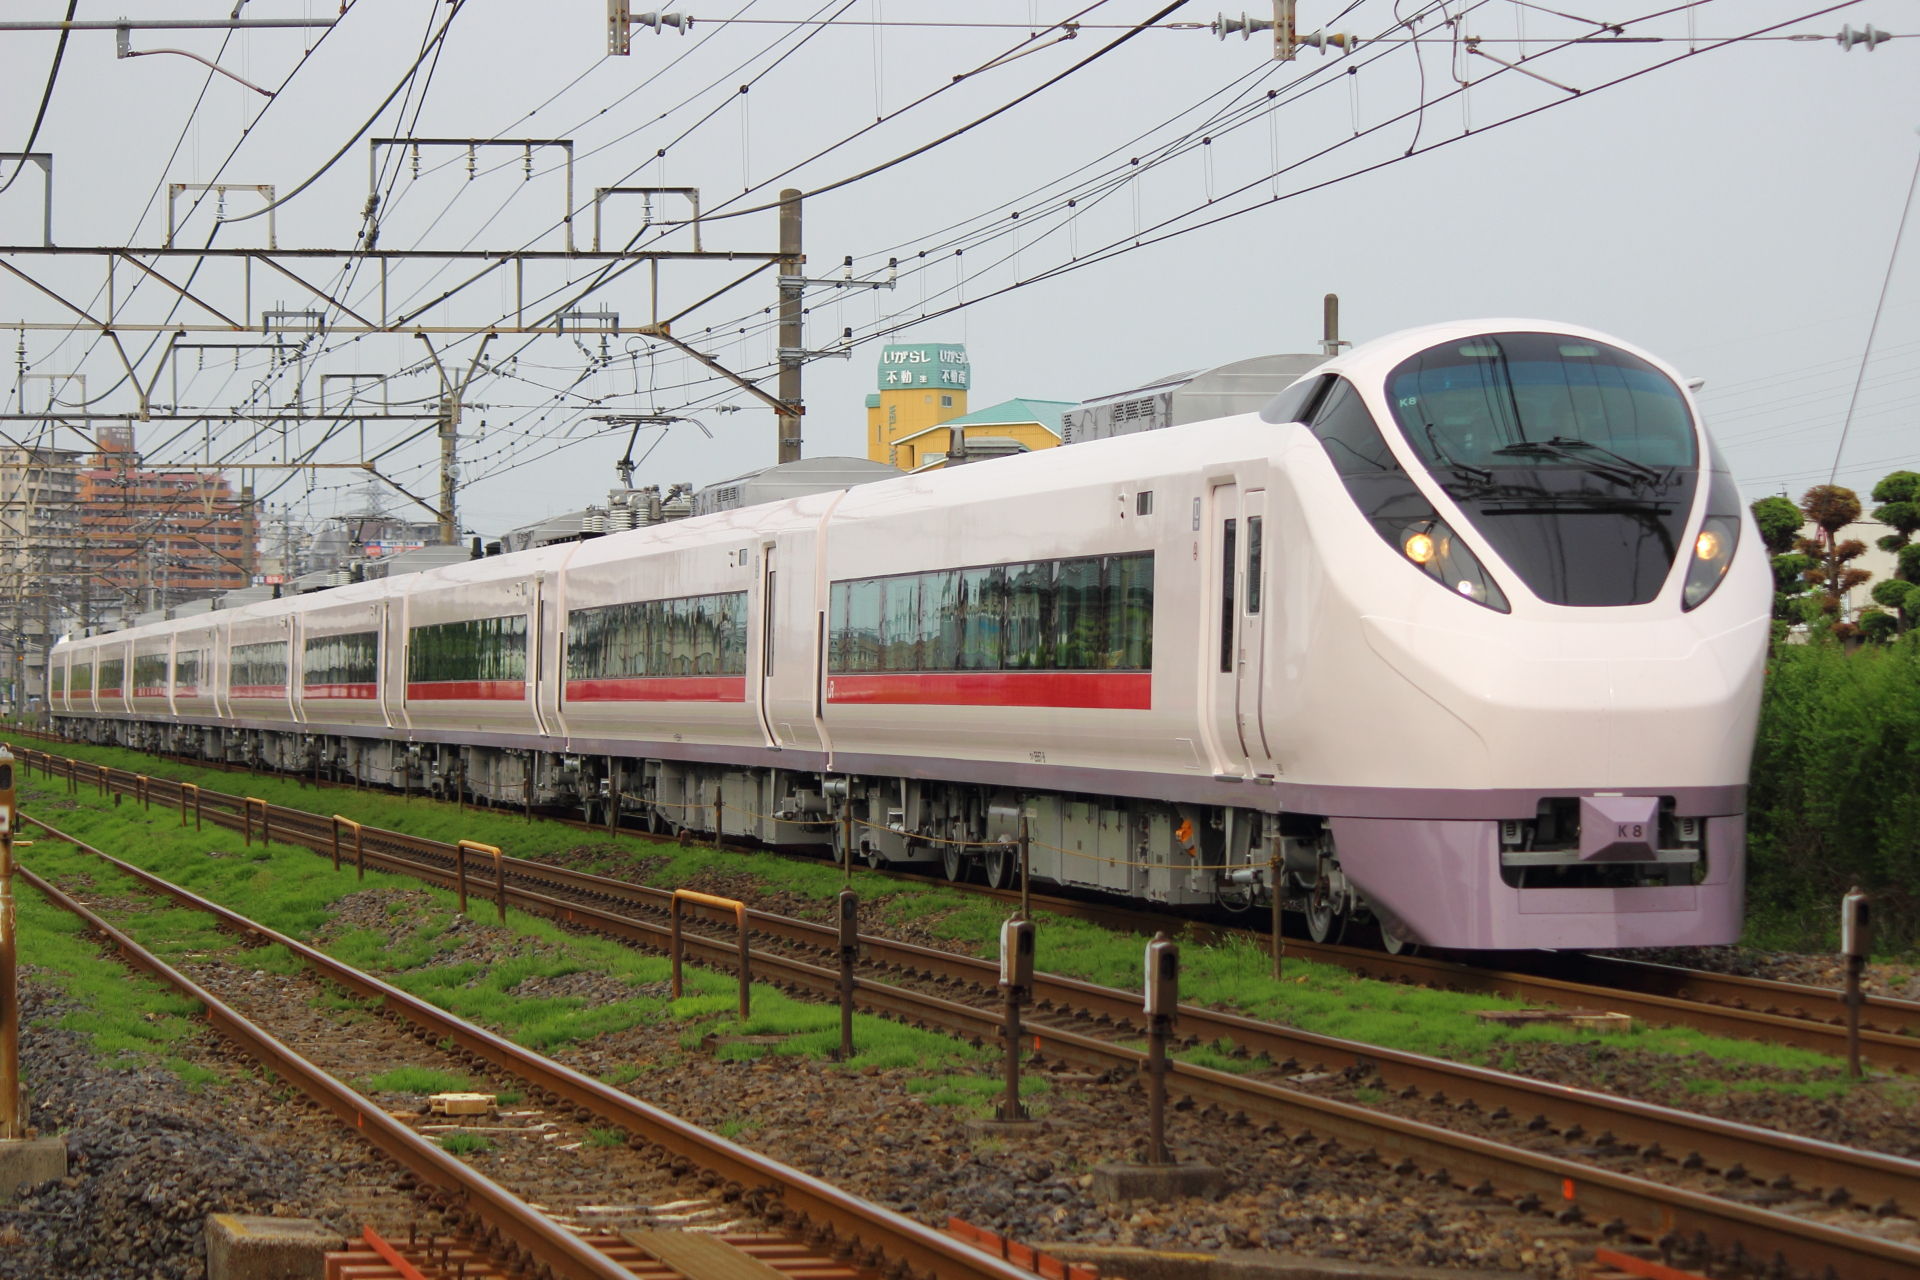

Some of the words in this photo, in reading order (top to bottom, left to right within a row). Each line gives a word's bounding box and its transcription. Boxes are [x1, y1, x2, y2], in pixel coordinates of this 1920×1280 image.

[883, 350, 931, 364] いがらし
[939, 349, 969, 364] いがらし
[941, 369, 967, 384] 不動産
[1399, 396, 1417, 408] K8
[827, 680, 834, 698] JR
